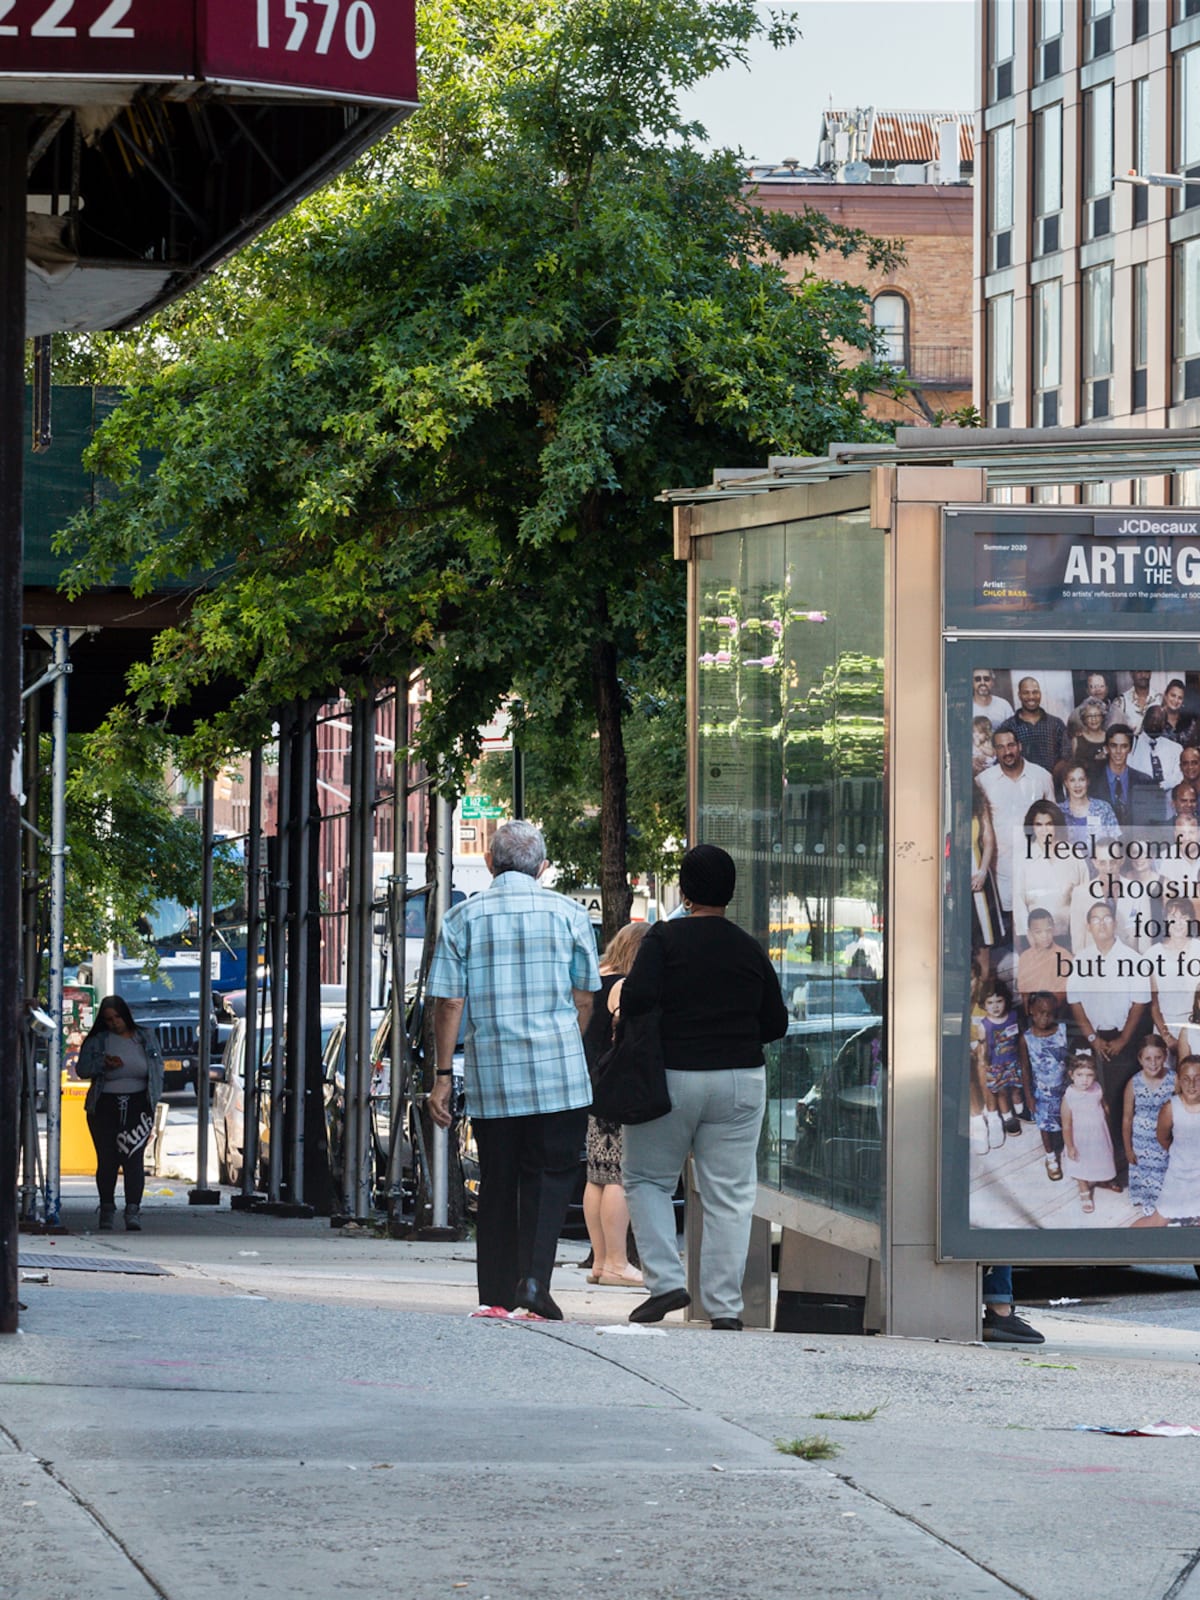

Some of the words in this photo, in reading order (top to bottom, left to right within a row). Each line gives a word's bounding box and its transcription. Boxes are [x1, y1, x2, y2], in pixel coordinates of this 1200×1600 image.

[256, 0, 376, 60] 1570
[1118, 519, 1198, 534] JCDecaux
[1063, 545, 1141, 585] ART
[1144, 546, 1172, 567] ON
[1143, 568, 1172, 584] THE
[1149, 592, 1180, 600] pandemic
[1024, 834, 1033, 860] I
[1043, 834, 1097, 860] feel
[1134, 912, 1175, 938] for
[1056, 952, 1104, 978] but
[1117, 955, 1166, 978] not
